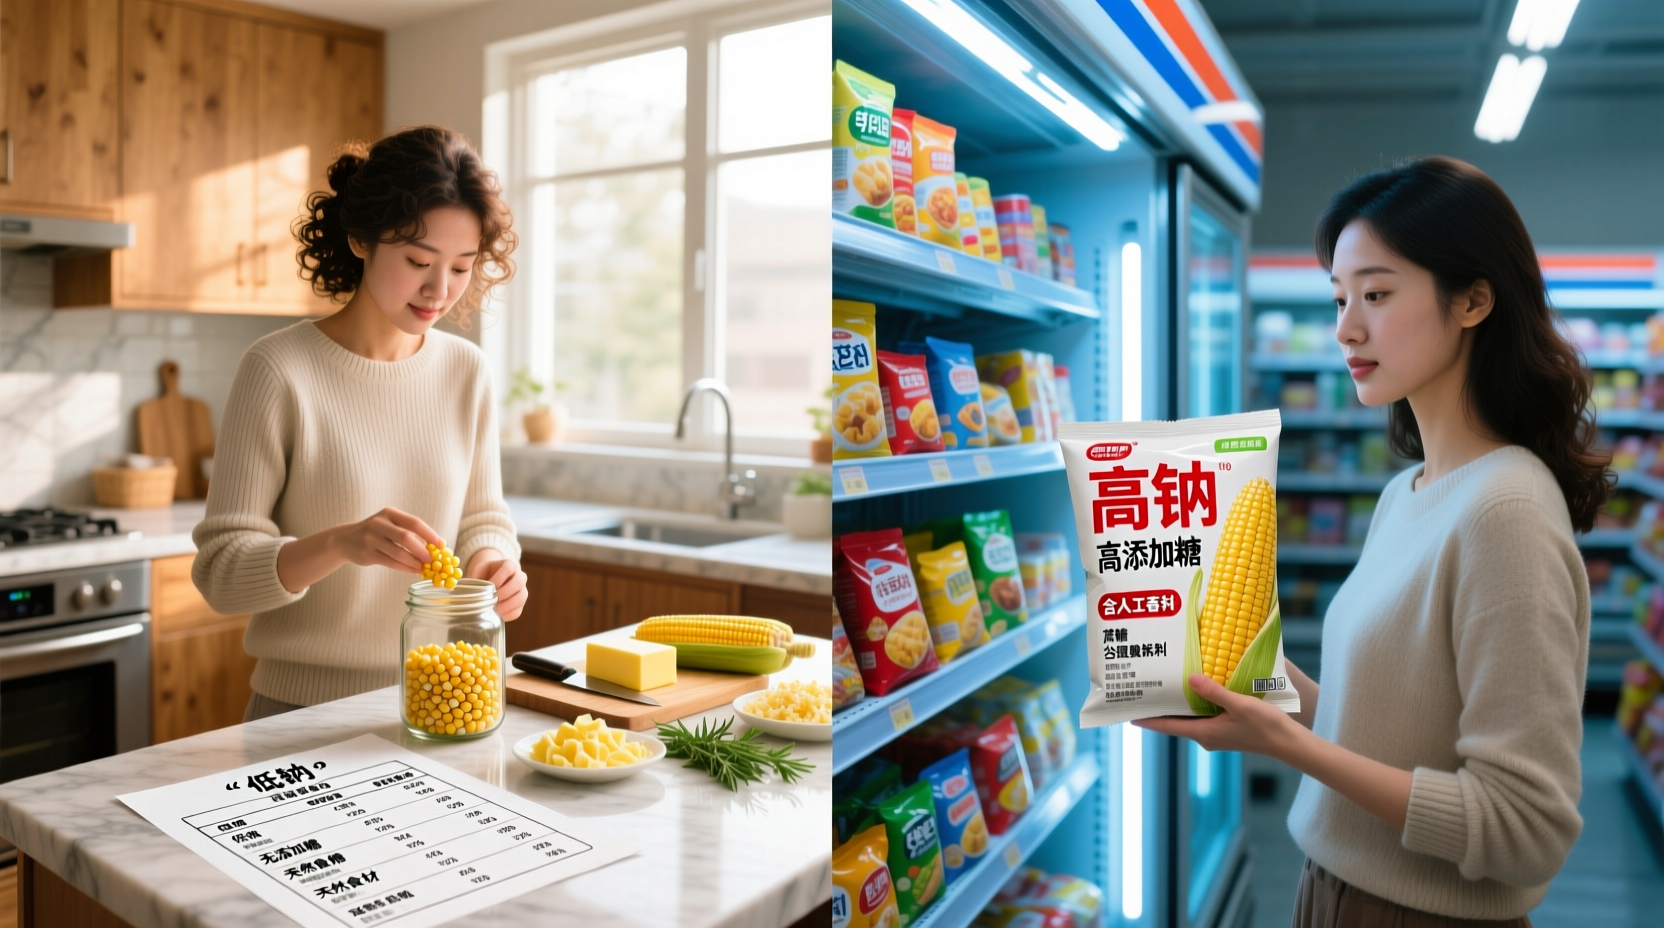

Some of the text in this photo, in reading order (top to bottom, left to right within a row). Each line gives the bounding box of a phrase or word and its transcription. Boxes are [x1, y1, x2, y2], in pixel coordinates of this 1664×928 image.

[1089, 460, 1217, 534] 高钠
[1096, 535, 1202, 574] 高添加糖
